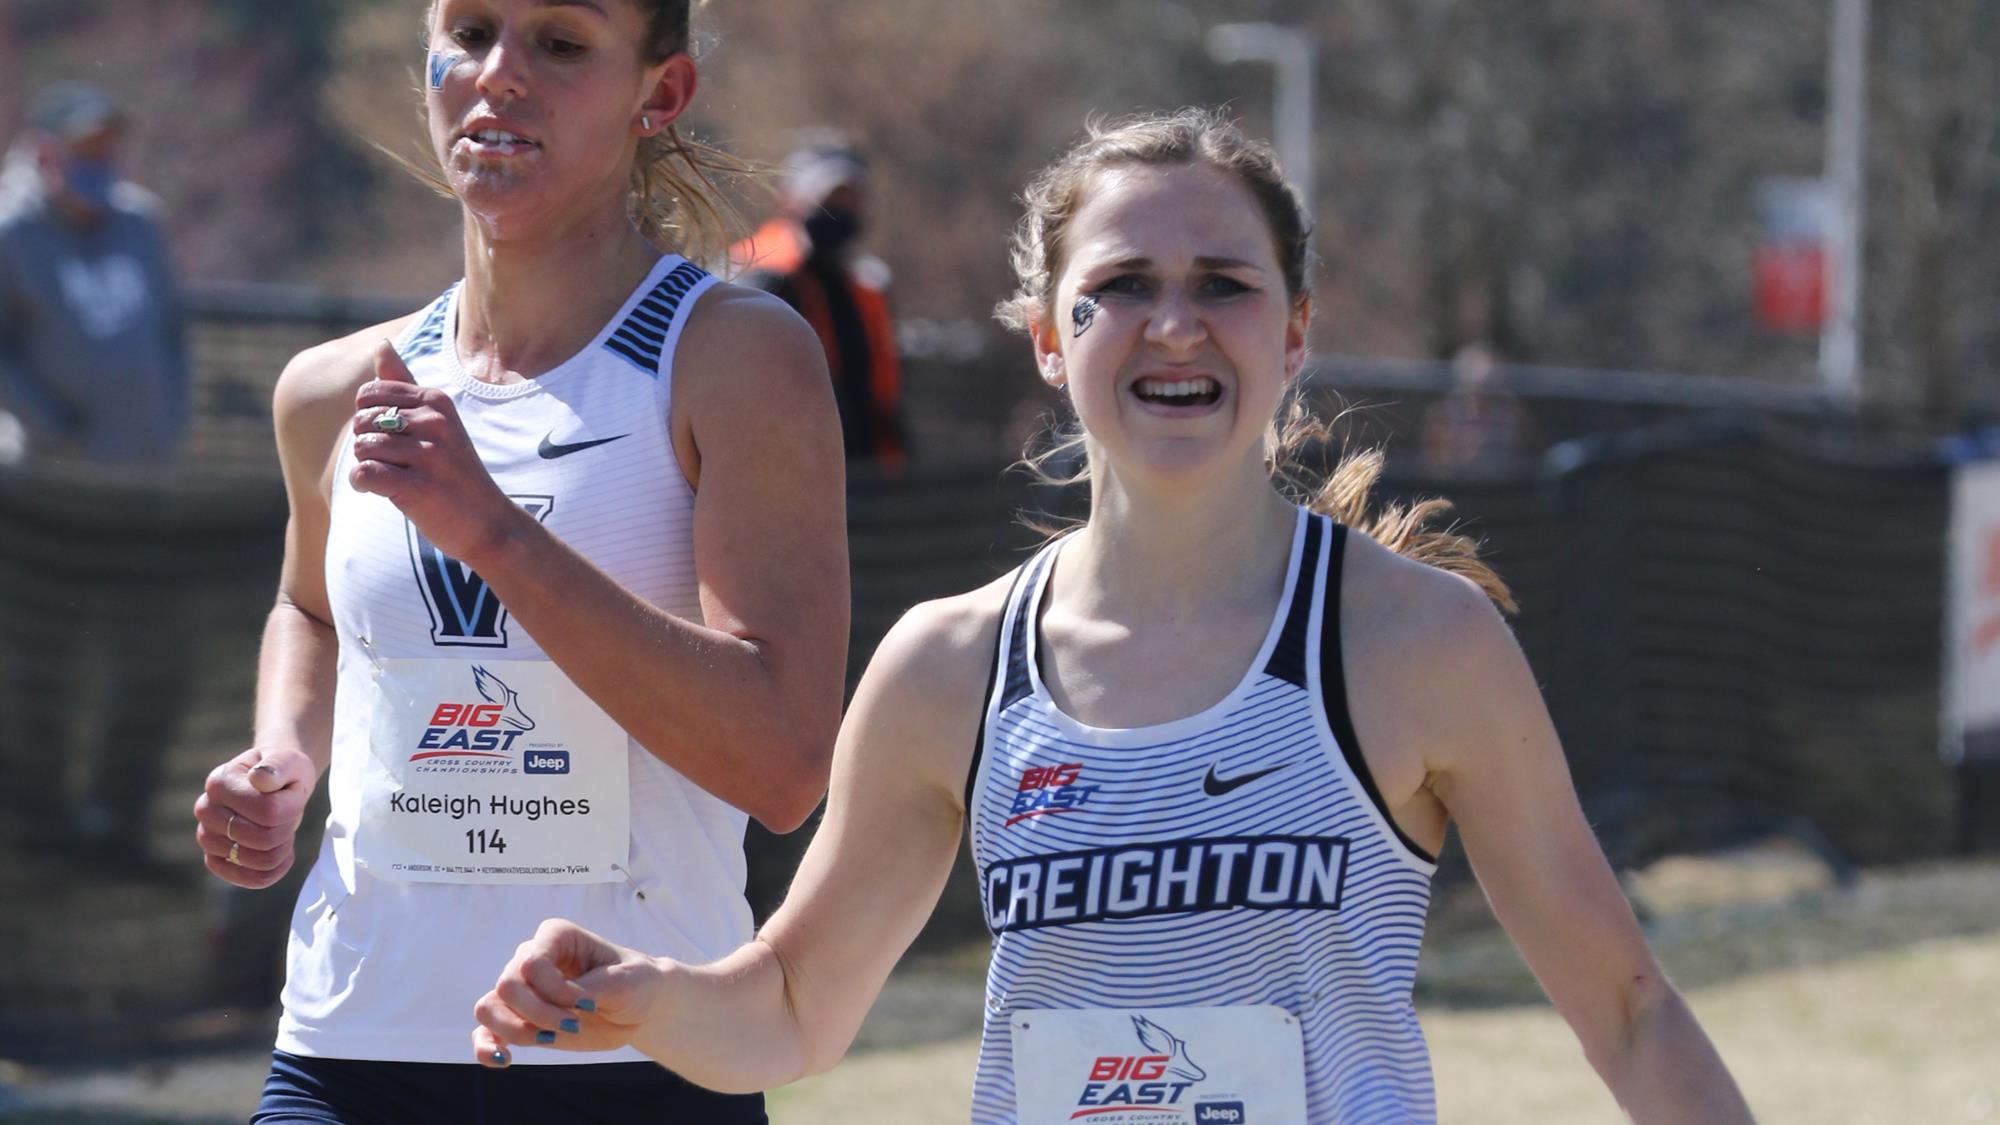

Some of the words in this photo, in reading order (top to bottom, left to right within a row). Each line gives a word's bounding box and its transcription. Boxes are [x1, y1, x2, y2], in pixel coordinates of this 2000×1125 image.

[429, 703, 504, 727] BIG
[417, 728, 524, 751] EAST
[528, 755, 566, 771] Jeep
[1018, 762, 1083, 792] BIG
[391, 793, 481, 819] Kaleigh
[490, 796, 590, 821] Hughes
[1010, 784, 1100, 814] EAST
[466, 829, 507, 853] 114
[567, 865, 590, 874] Tyvek
[986, 841, 1344, 930] CREIGHTON
[1089, 1056, 1170, 1081] BIG
[1077, 1082, 1194, 1106] EAST
[1200, 1106, 1239, 1121] Jeep
